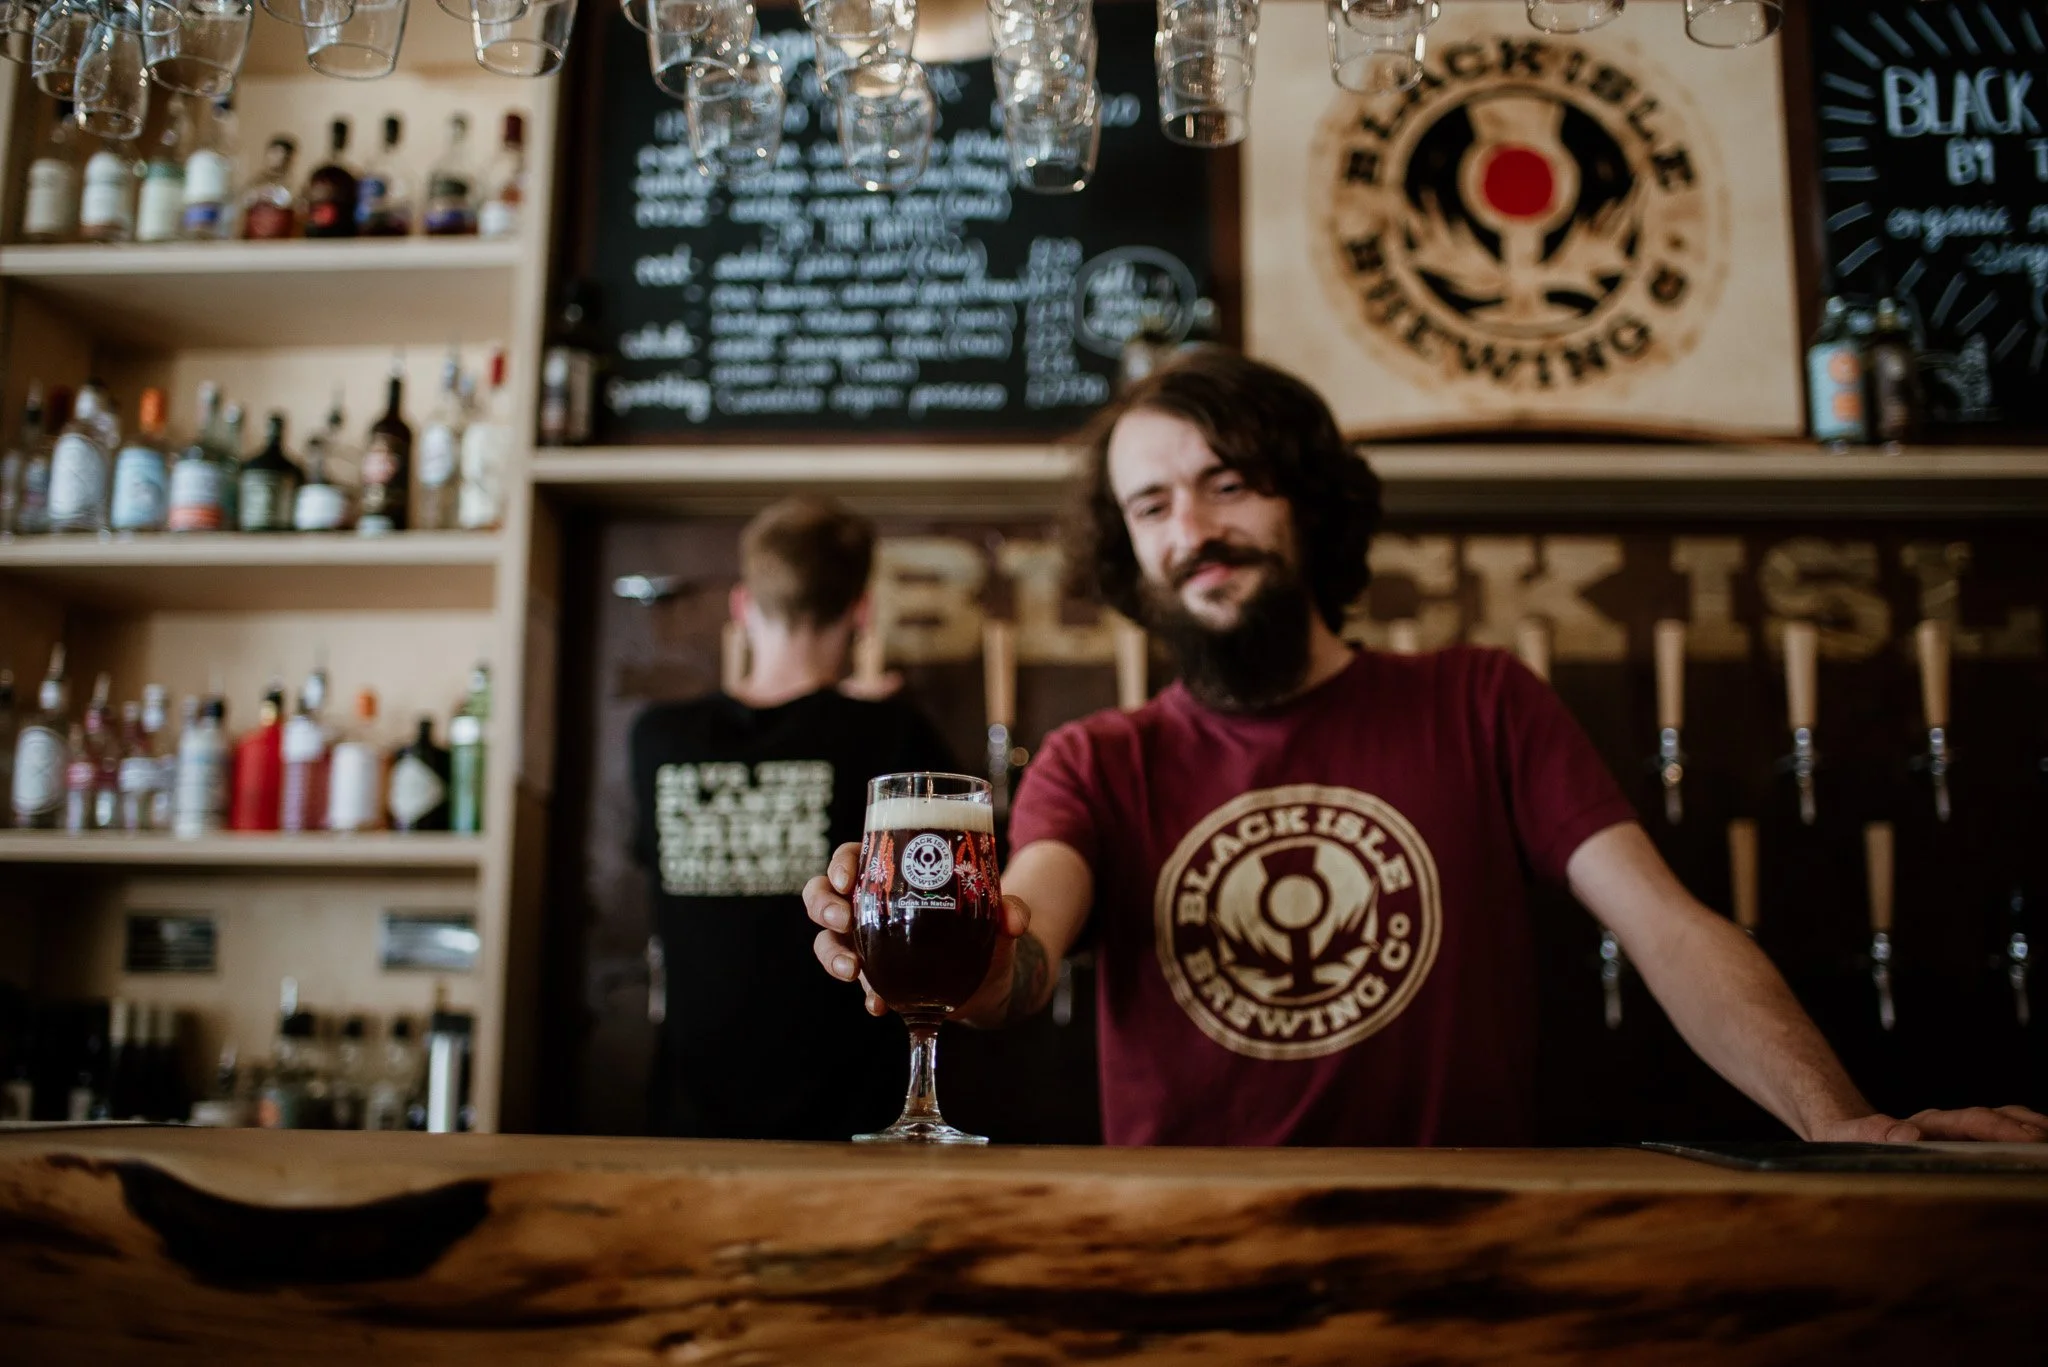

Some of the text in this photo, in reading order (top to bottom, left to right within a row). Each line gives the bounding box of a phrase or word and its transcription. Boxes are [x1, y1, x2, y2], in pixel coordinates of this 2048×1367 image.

[1566, 49, 1696, 194] ISLE
[1884, 65, 2040, 137] BLACK
[874, 534, 1629, 666] BLCK
[906, 837, 950, 860] BLACK ISLE
[906, 865, 944, 886] BREWING
[1178, 805, 1414, 927] BLACK ISLE
[930, 900, 954, 908] Nature
[1183, 947, 1390, 1038] BREWING
